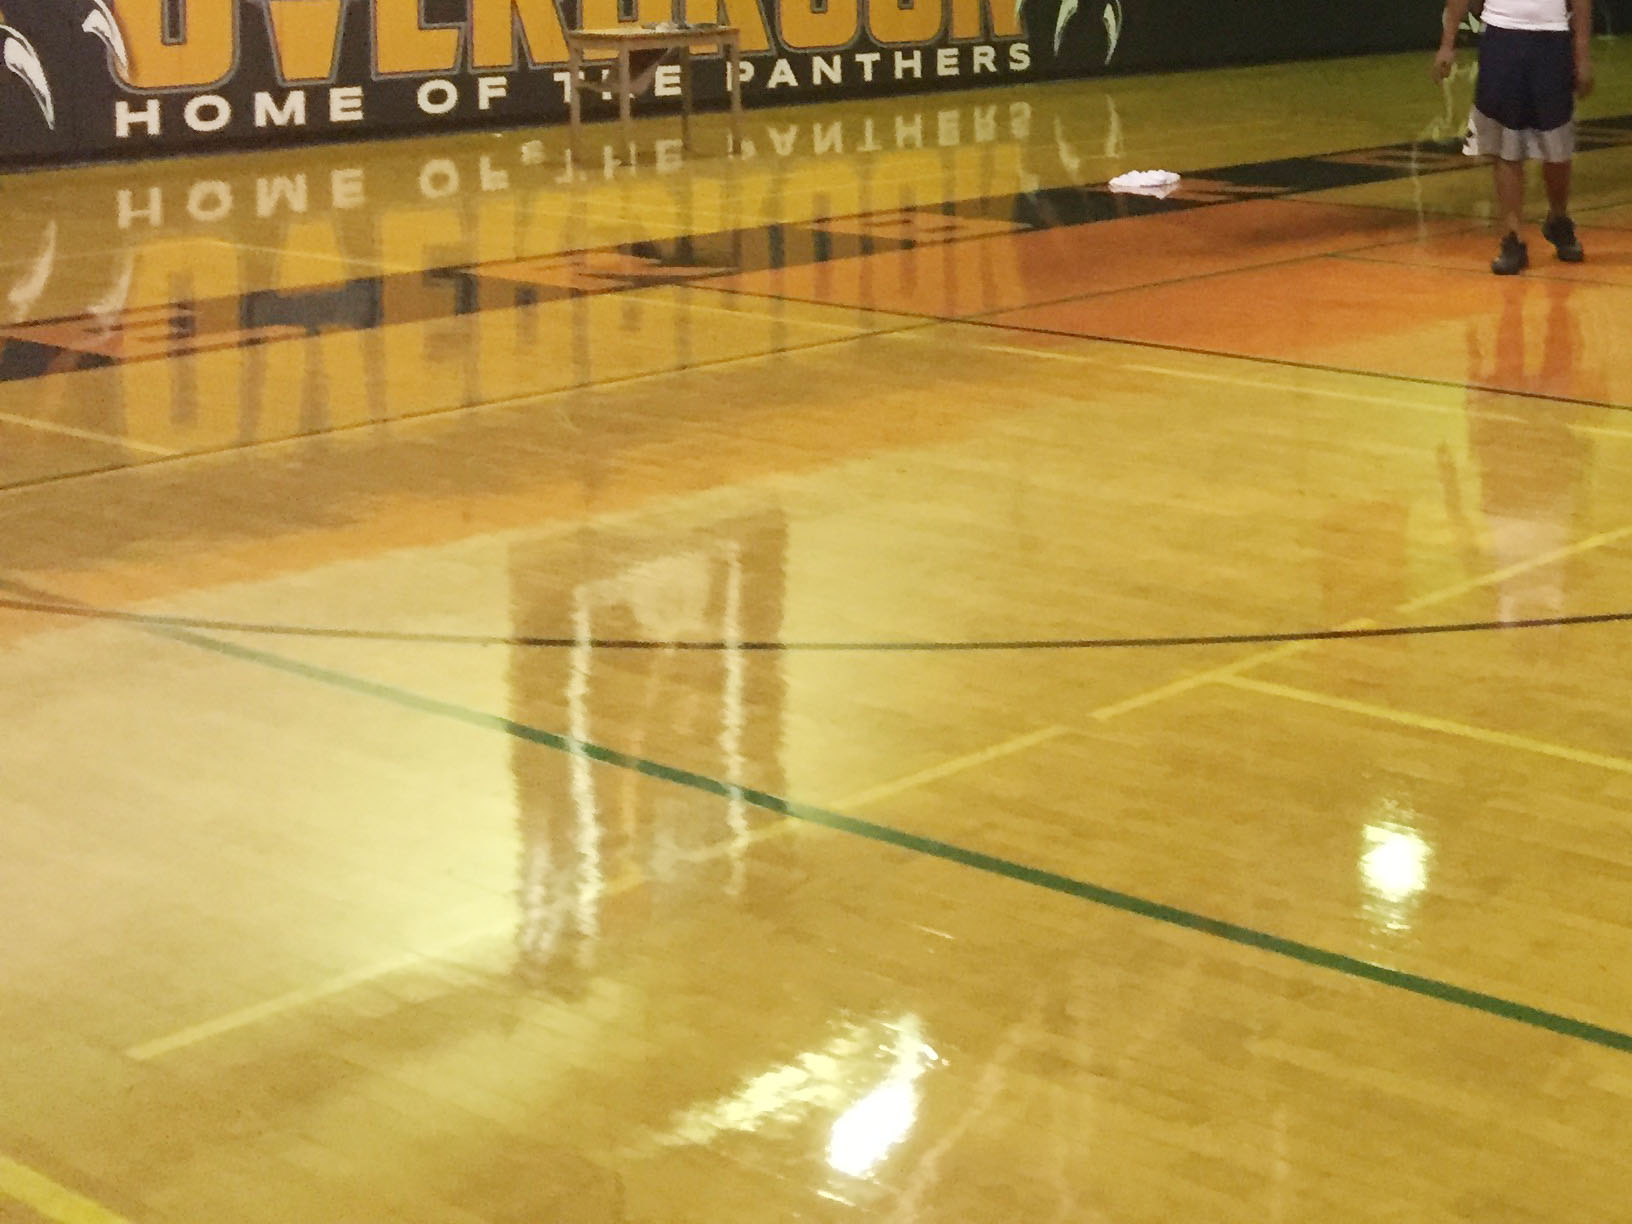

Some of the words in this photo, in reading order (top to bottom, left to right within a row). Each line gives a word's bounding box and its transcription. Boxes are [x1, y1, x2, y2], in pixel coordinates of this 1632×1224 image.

[115, 86, 364, 137] HOME
[417, 76, 508, 114] OF
[553, 65, 682, 103] TE
[726, 43, 1031, 91] PANTHERS
